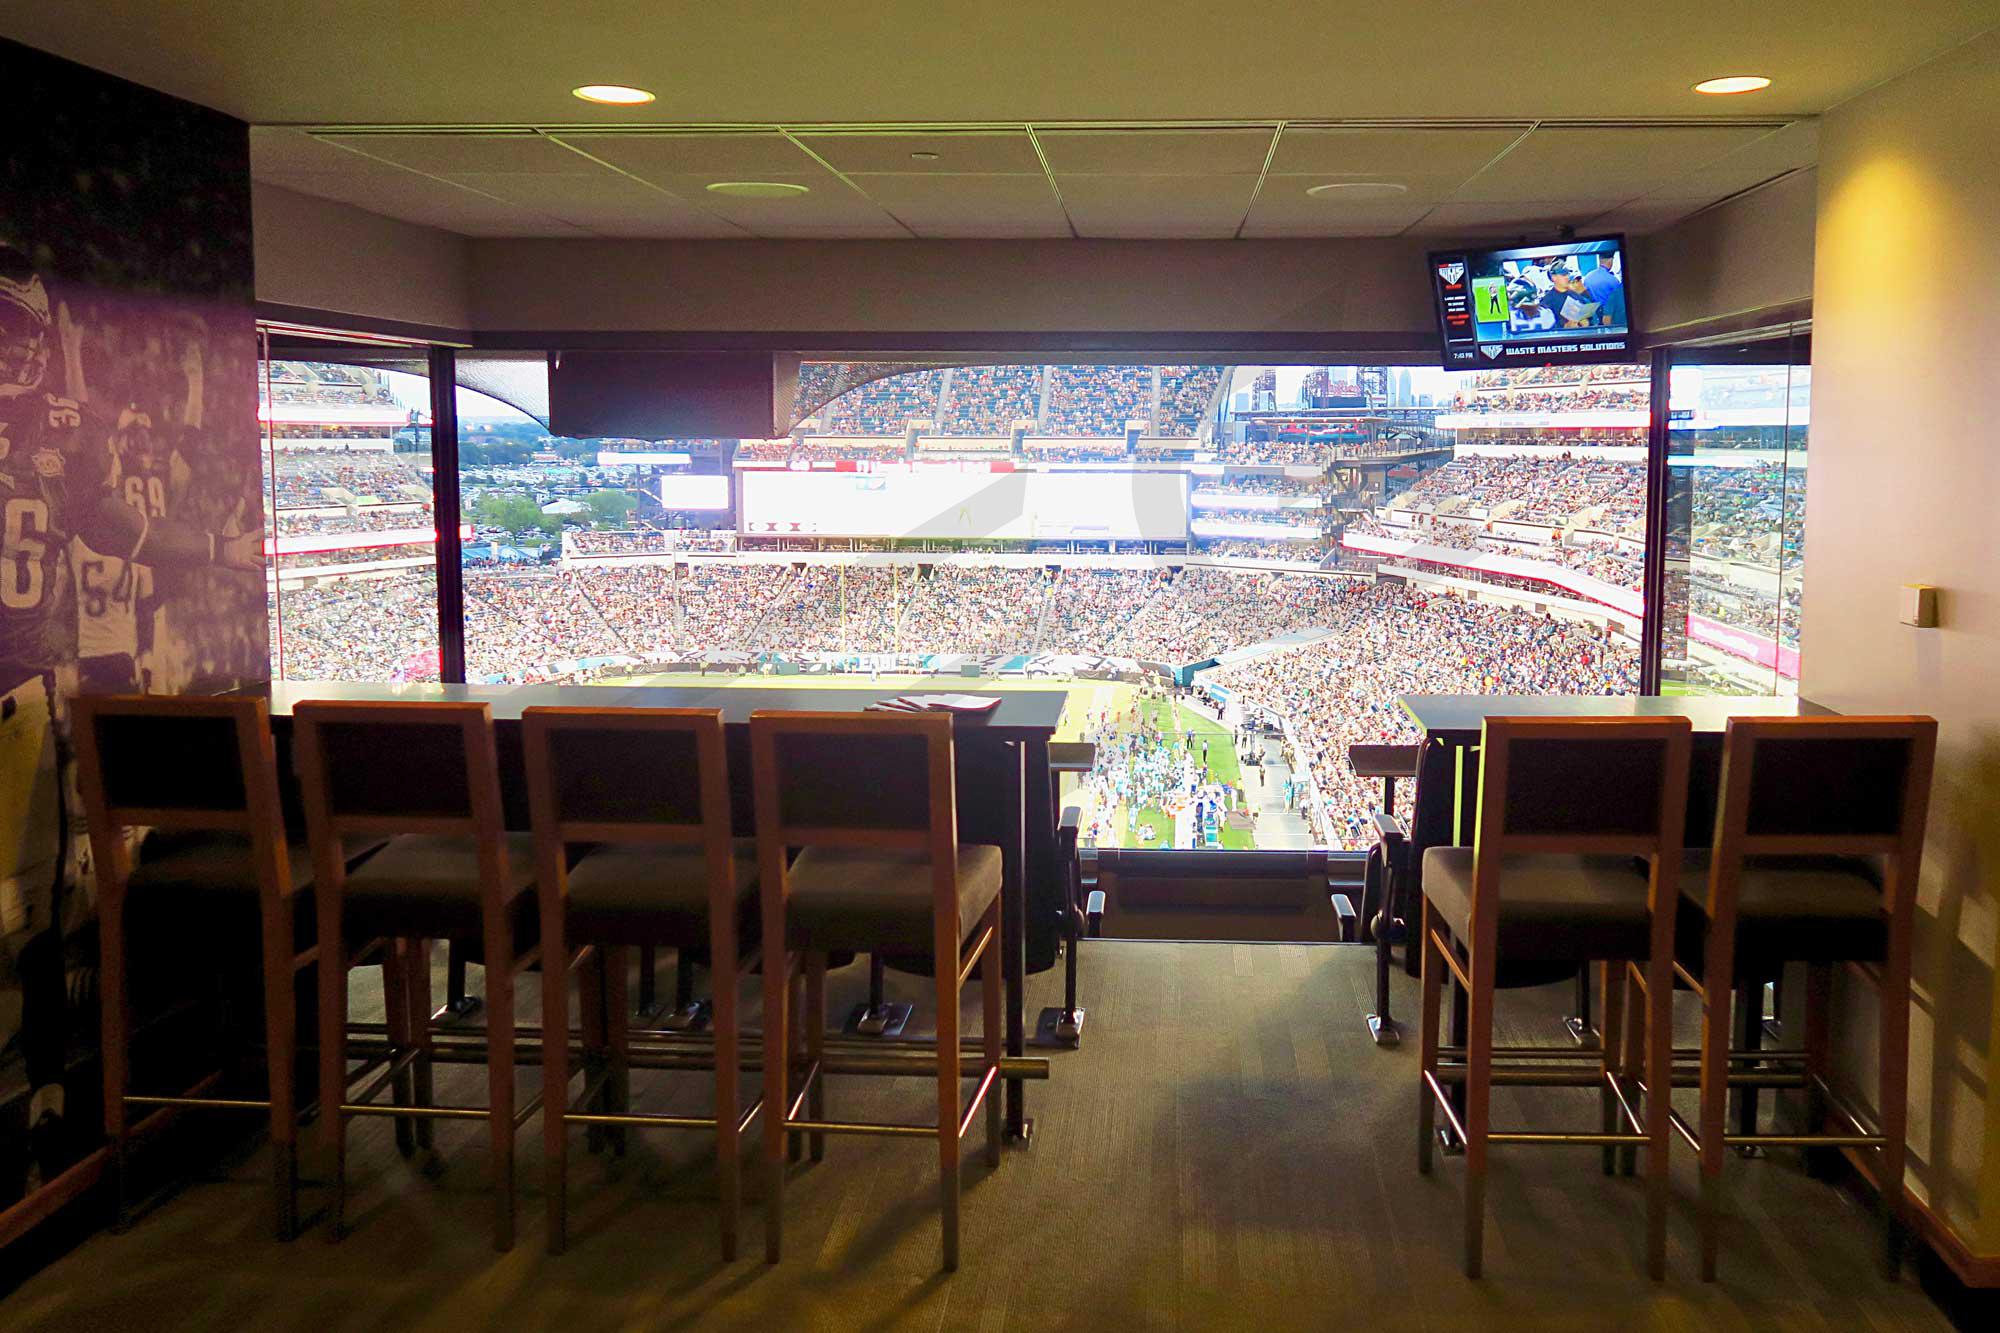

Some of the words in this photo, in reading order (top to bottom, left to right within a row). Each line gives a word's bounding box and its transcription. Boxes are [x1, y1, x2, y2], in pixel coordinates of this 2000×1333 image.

[1506, 347, 1535, 355] WASTE
[1537, 345, 1578, 354] MASTERS
[1580, 342, 1625, 352] SOLUTIONS
